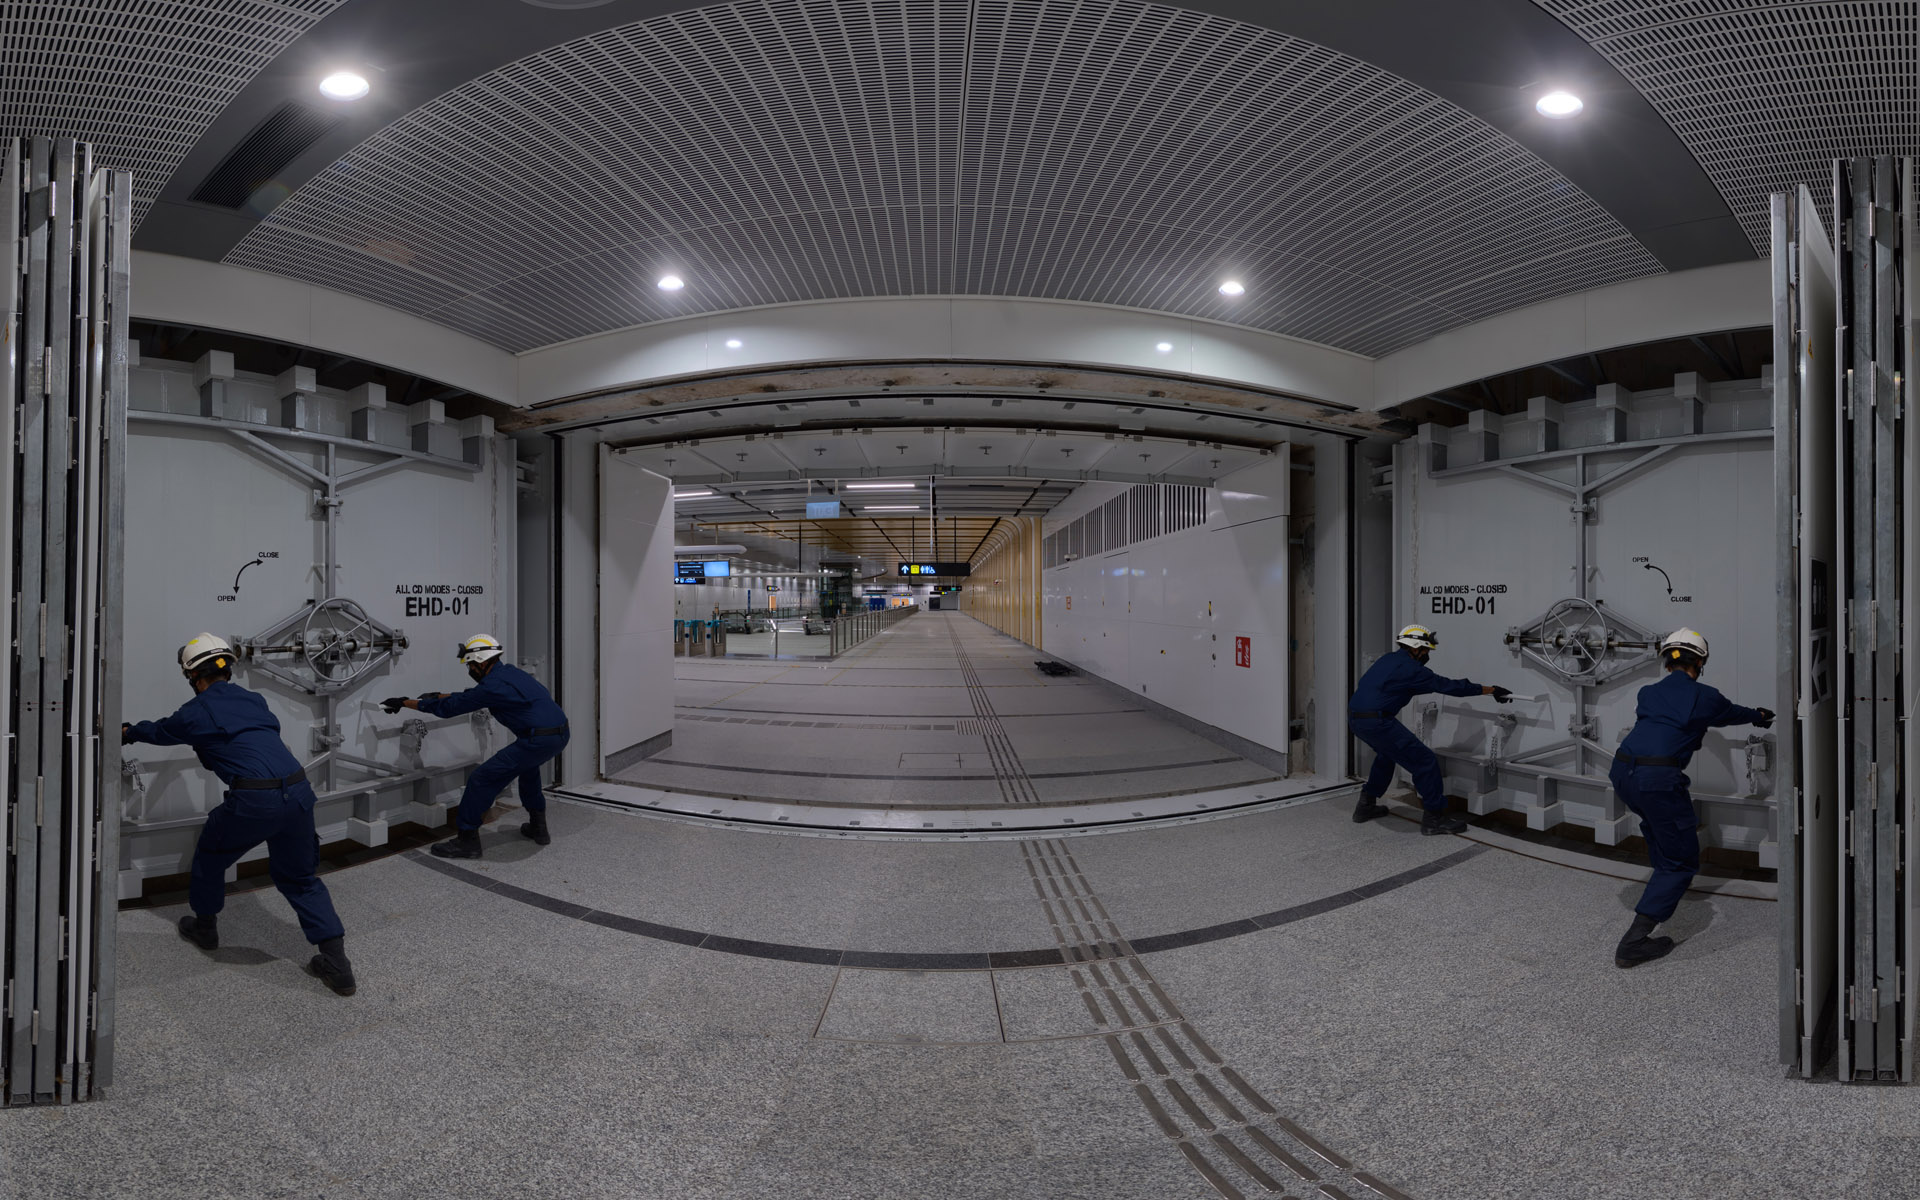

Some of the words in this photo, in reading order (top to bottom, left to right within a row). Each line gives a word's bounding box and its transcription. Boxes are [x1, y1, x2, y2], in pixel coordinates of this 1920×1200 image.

[395, 584, 410, 594] ALL
[412, 584, 423, 594] CD
[424, 584, 450, 594] MODES
[457, 585, 483, 594] CLOSED
[1420, 585, 1432, 595] ALL
[1433, 585, 1443, 594] CD
[1444, 584, 1469, 594] MODES
[1476, 584, 1508, 594] CLOSED
[405, 596, 469, 617] EHD-01
[1431, 596, 1495, 615] EHD-01
